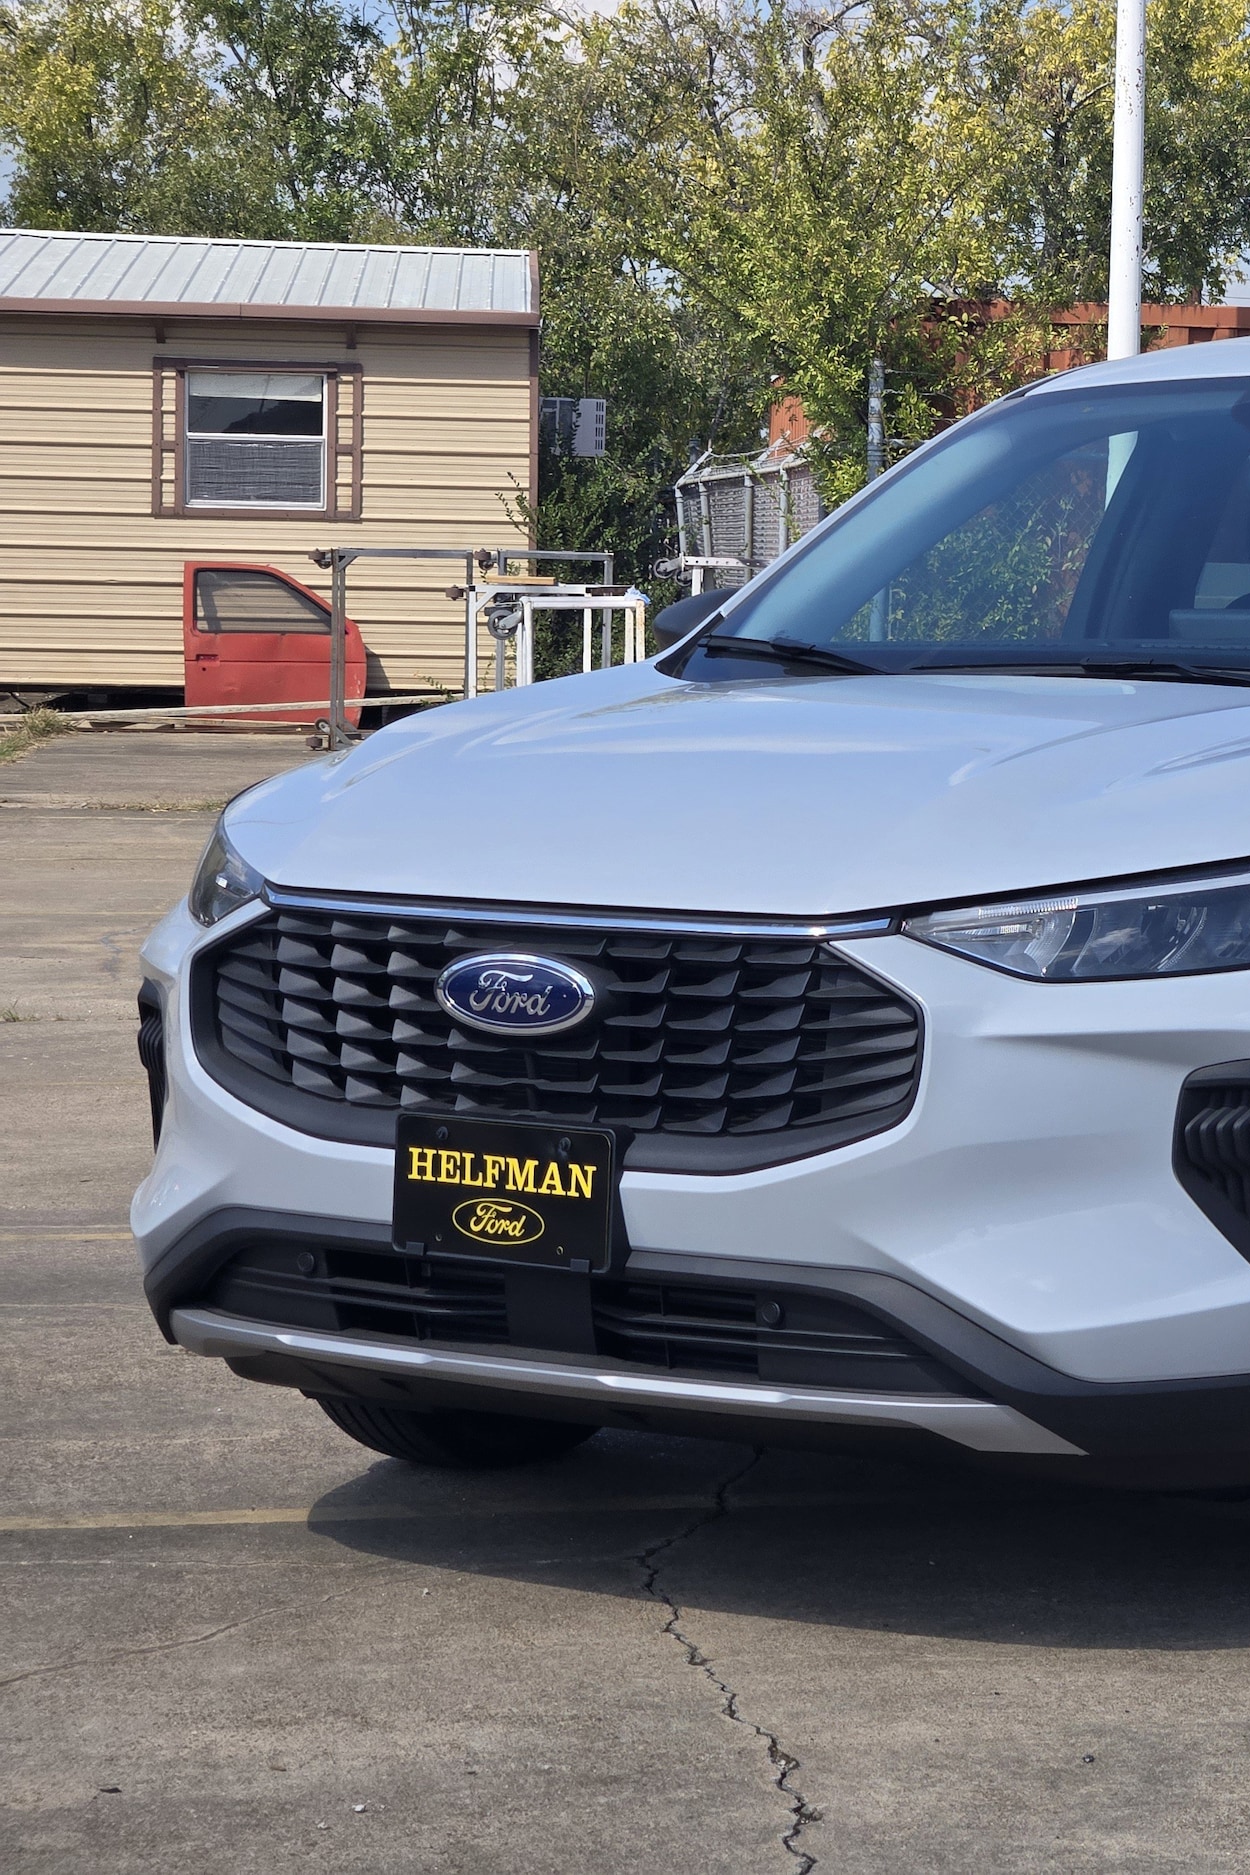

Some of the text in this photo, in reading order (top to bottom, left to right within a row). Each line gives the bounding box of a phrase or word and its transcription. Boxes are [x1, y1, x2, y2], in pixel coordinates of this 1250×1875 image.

[468, 969, 553, 1016] Ford
[407, 1147, 597, 1199] HELFMAN
[469, 1202, 526, 1238] Ford
